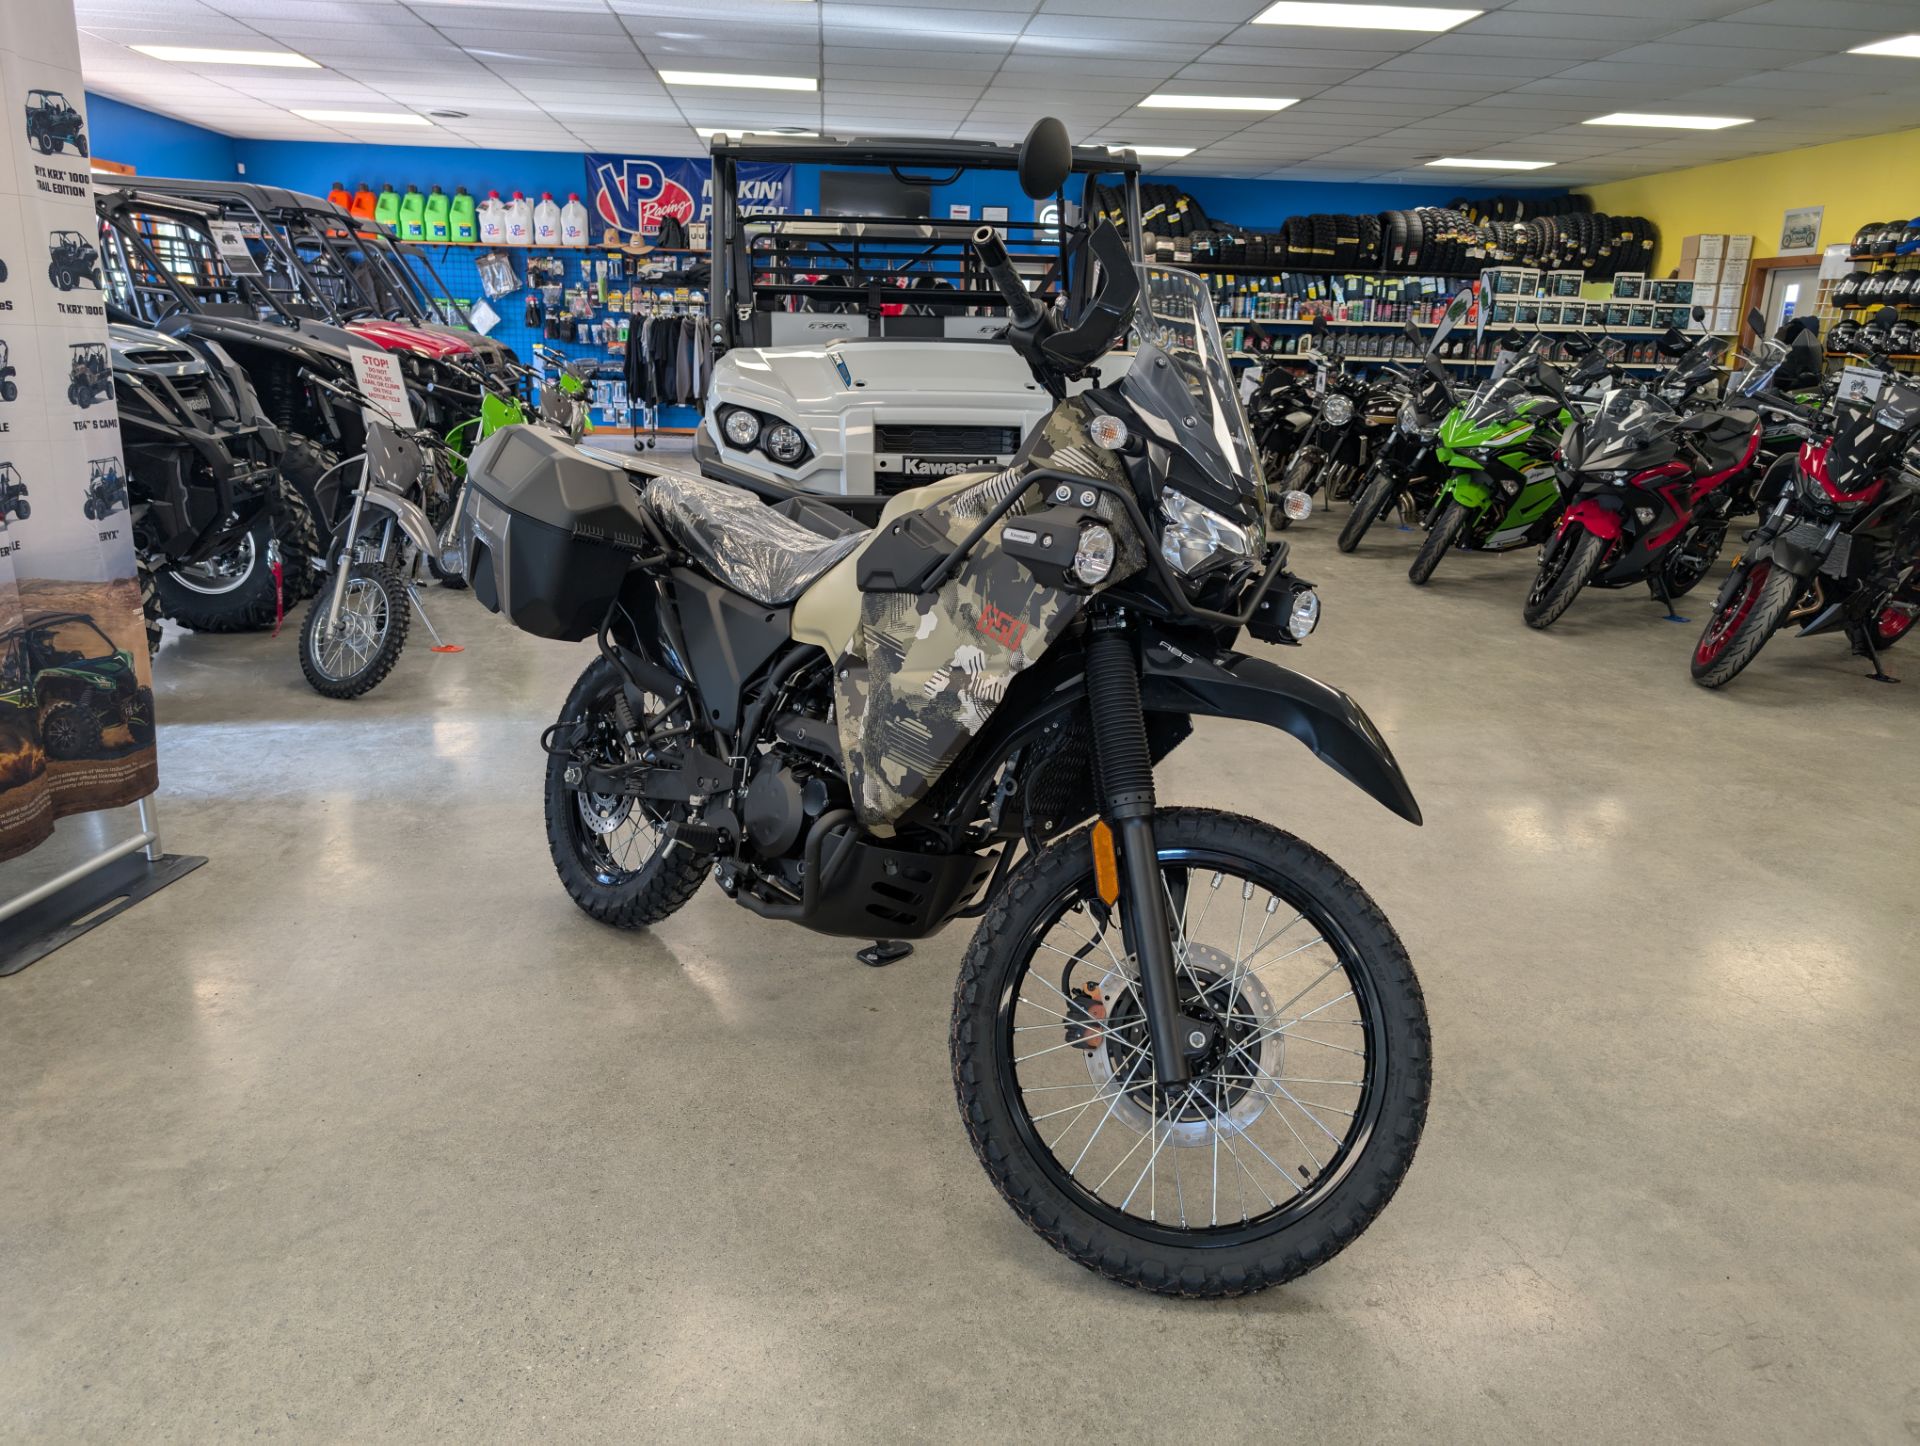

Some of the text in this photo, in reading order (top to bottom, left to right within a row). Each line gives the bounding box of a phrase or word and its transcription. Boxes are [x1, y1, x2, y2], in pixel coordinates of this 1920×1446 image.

[69, 172, 89, 184] 1000
[53, 183, 85, 197] EDITION
[597, 160, 665, 236] VP
[702, 180, 782, 199] MKIN'
[643, 200, 692, 224] Racing
[85, 305, 104, 315] 1000
[362, 355, 389, 369] STOP!
[905, 459, 995, 475] Kawas
[976, 604, 1028, 652] 650
[1159, 640, 1194, 664] ABS
